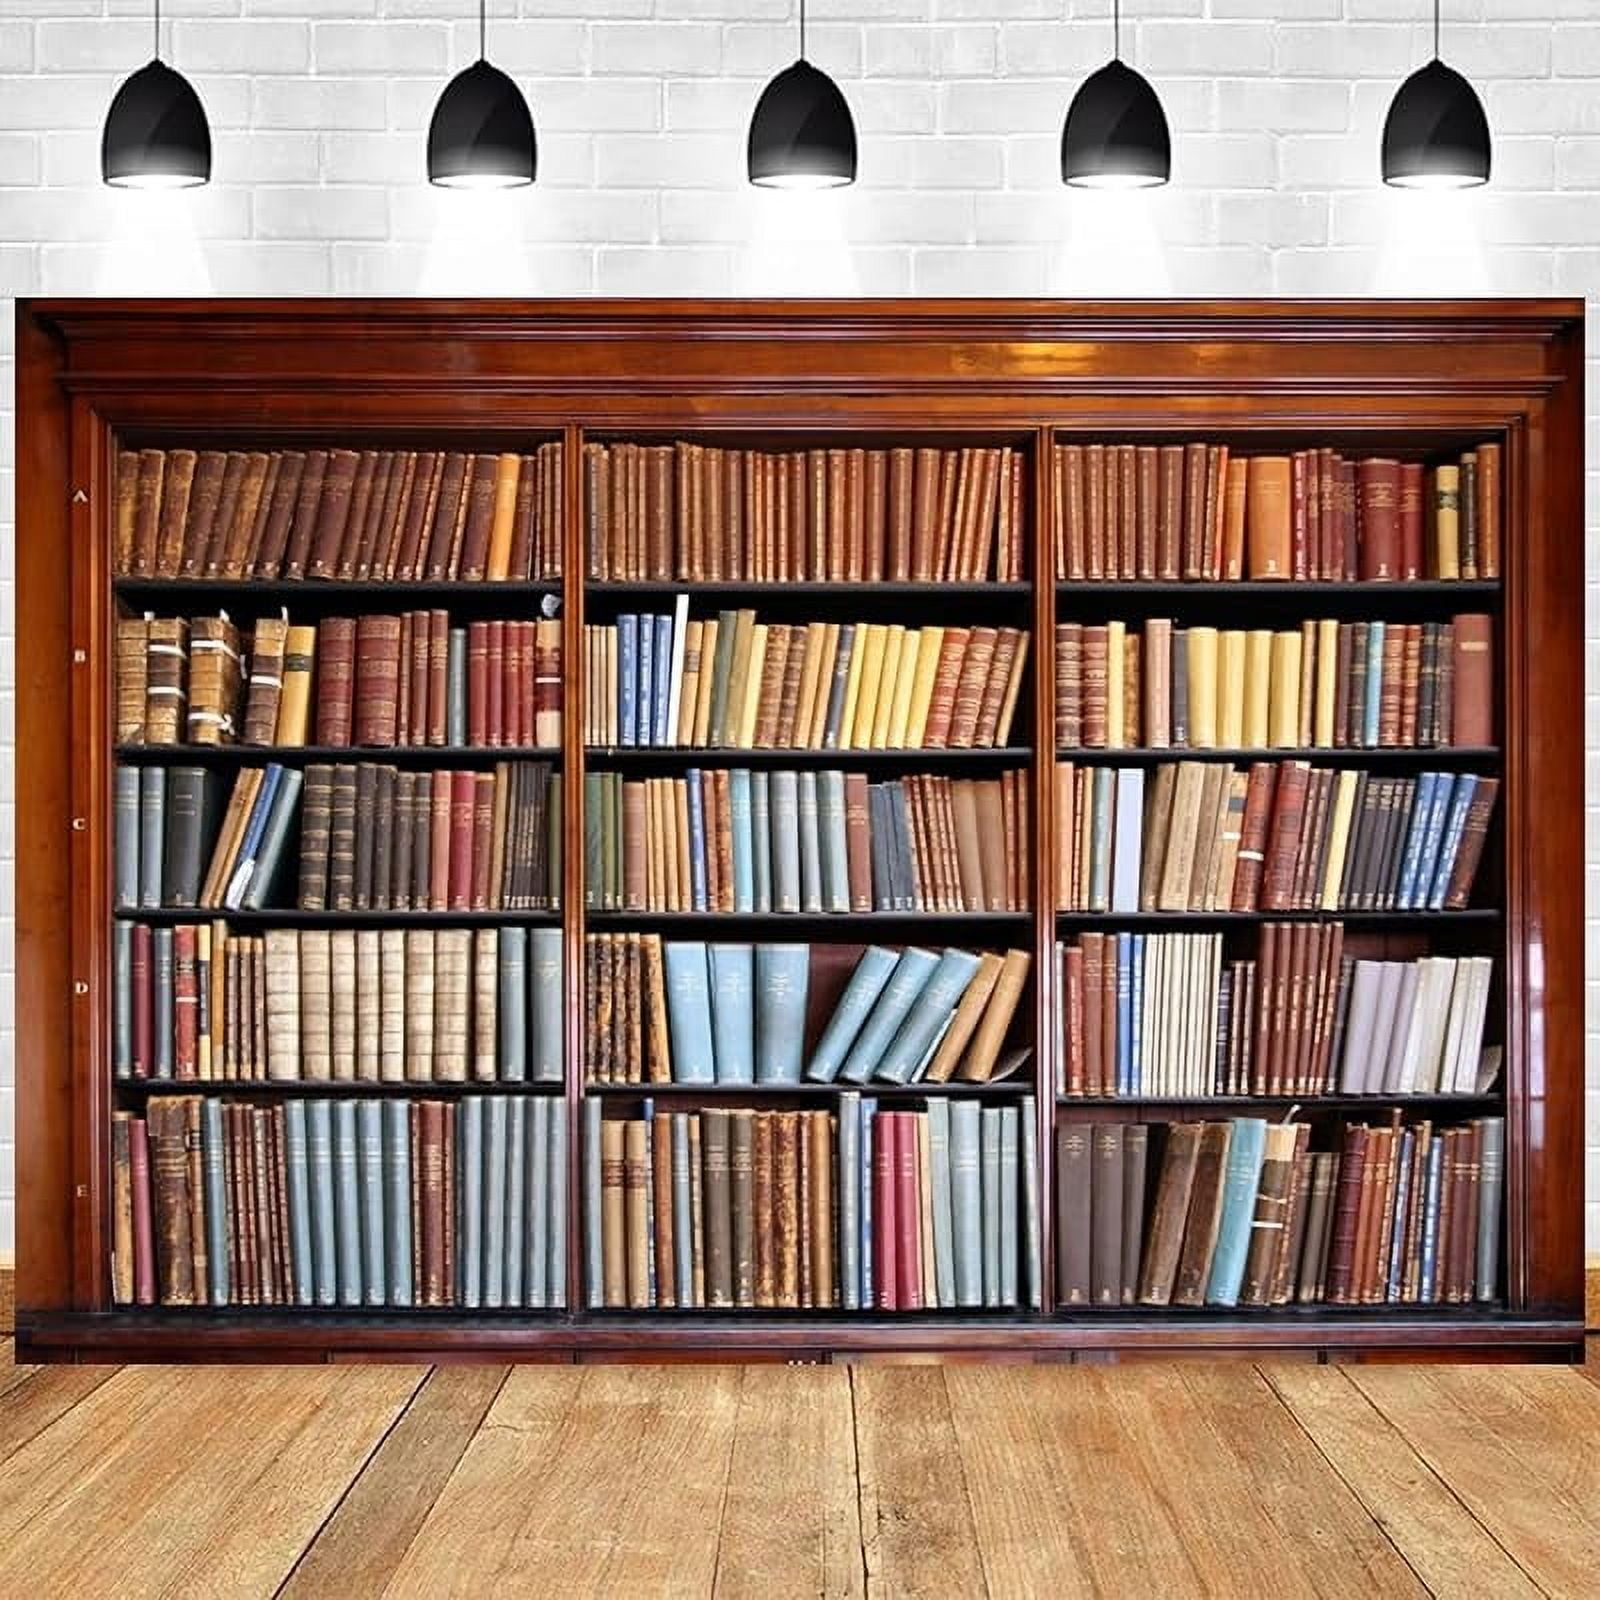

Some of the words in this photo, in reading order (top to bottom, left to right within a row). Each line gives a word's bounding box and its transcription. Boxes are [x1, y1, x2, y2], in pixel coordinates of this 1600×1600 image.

[73, 490, 88, 502] A
[74, 650, 85, 662] B
[73, 818, 85, 830] C
[75, 982, 88, 993] D
[77, 1184, 88, 1197] E
